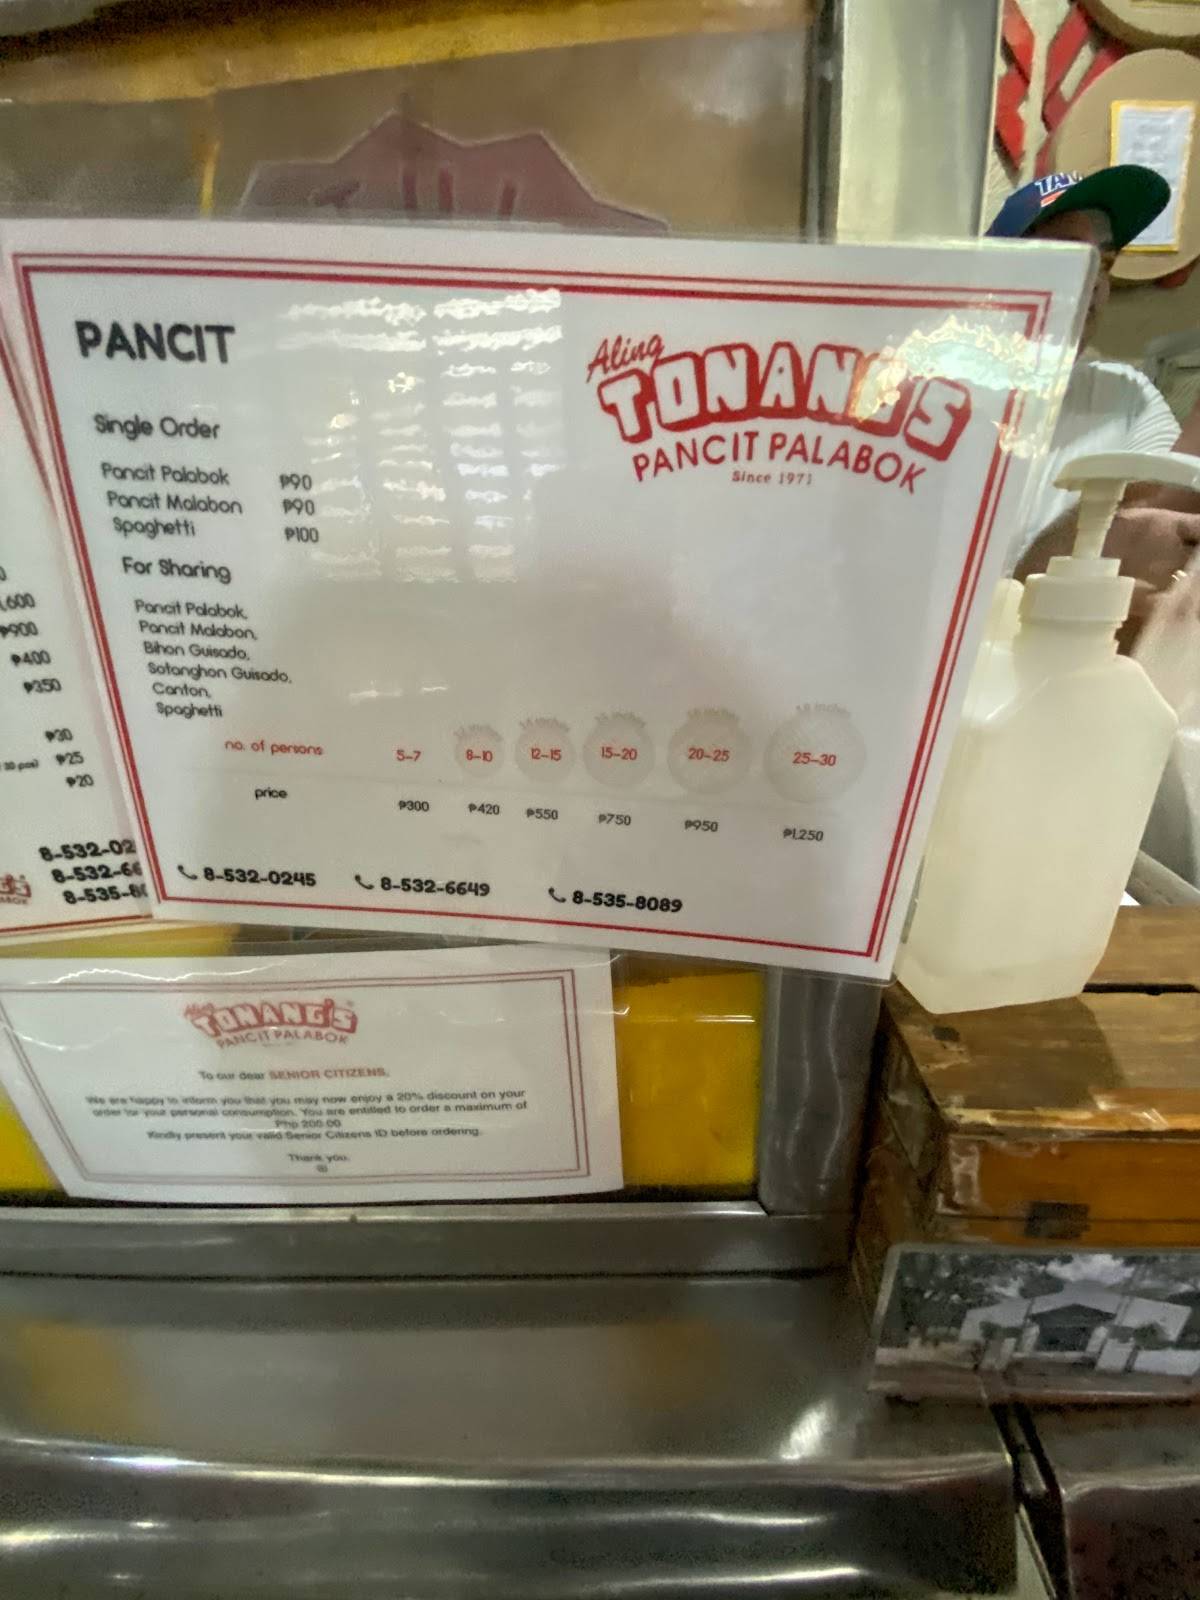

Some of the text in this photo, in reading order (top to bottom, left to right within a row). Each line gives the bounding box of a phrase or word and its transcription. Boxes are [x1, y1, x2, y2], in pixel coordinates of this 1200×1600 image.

[75, 321, 235, 363] PANCIT
[587, 334, 664, 383] Aling
[597, 341, 972, 462] TONANS
[94, 415, 220, 441] Single Order
[632, 431, 926, 494] PANCIT PALABOK
[101, 462, 156, 481] Pancit
[161, 464, 230, 486] Palabok
[732, 470, 812, 485] Since 1971
[107, 490, 161, 508] Pancit
[167, 494, 244, 514] Malabon
[113, 516, 196, 540] Spaghetti
[122, 556, 232, 585] For Sharing
[134, 599, 182, 615] Pancit
[139, 620, 185, 635] Pancit
[143, 640, 185, 656] Bihon
[148, 662, 227, 680] Sotanghon
[156, 702, 223, 719] Spaghetti
[225, 739, 837, 766] no. of persons 5-7 8-10 12-15 15-20 20-25 25-30
[254, 787, 288, 800] price
[203, 867, 683, 912] 8-532-0245 8-532-6649 8-535-8089
[191, 998, 358, 1038] TONANG'S
[216, 1030, 270, 1049] PANCIT
[274, 1029, 348, 1044] PALABOK
[199, 1071, 214, 1080] To
[239, 1071, 265, 1080] dear
[268, 1069, 320, 1080] SENIOR
[129, 1096, 164, 1106] happy
[222, 1097, 242, 1107] you
[271, 1096, 291, 1106] you
[351, 1094, 382, 1104] enjoy
[427, 1090, 477, 1100] discount
[480, 1091, 496, 1099] on
[499, 1089, 526, 1099] your
[170, 1107, 219, 1118] personal
[301, 1108, 323, 1116] You
[349, 1104, 391, 1114] entitled
[394, 1105, 406, 1113] to
[409, 1103, 440, 1113] order
[455, 1102, 512, 1112] maximum
[515, 1101, 528, 1110] of
[184, 1131, 226, 1141] present
[228, 1132, 252, 1141] your
[285, 1130, 322, 1140] Senior
[325, 1129, 372, 1139] Citizens
[375, 1128, 388, 1137] ID
[391, 1127, 428, 1137] before
[288, 1153, 322, 1162] Thank
